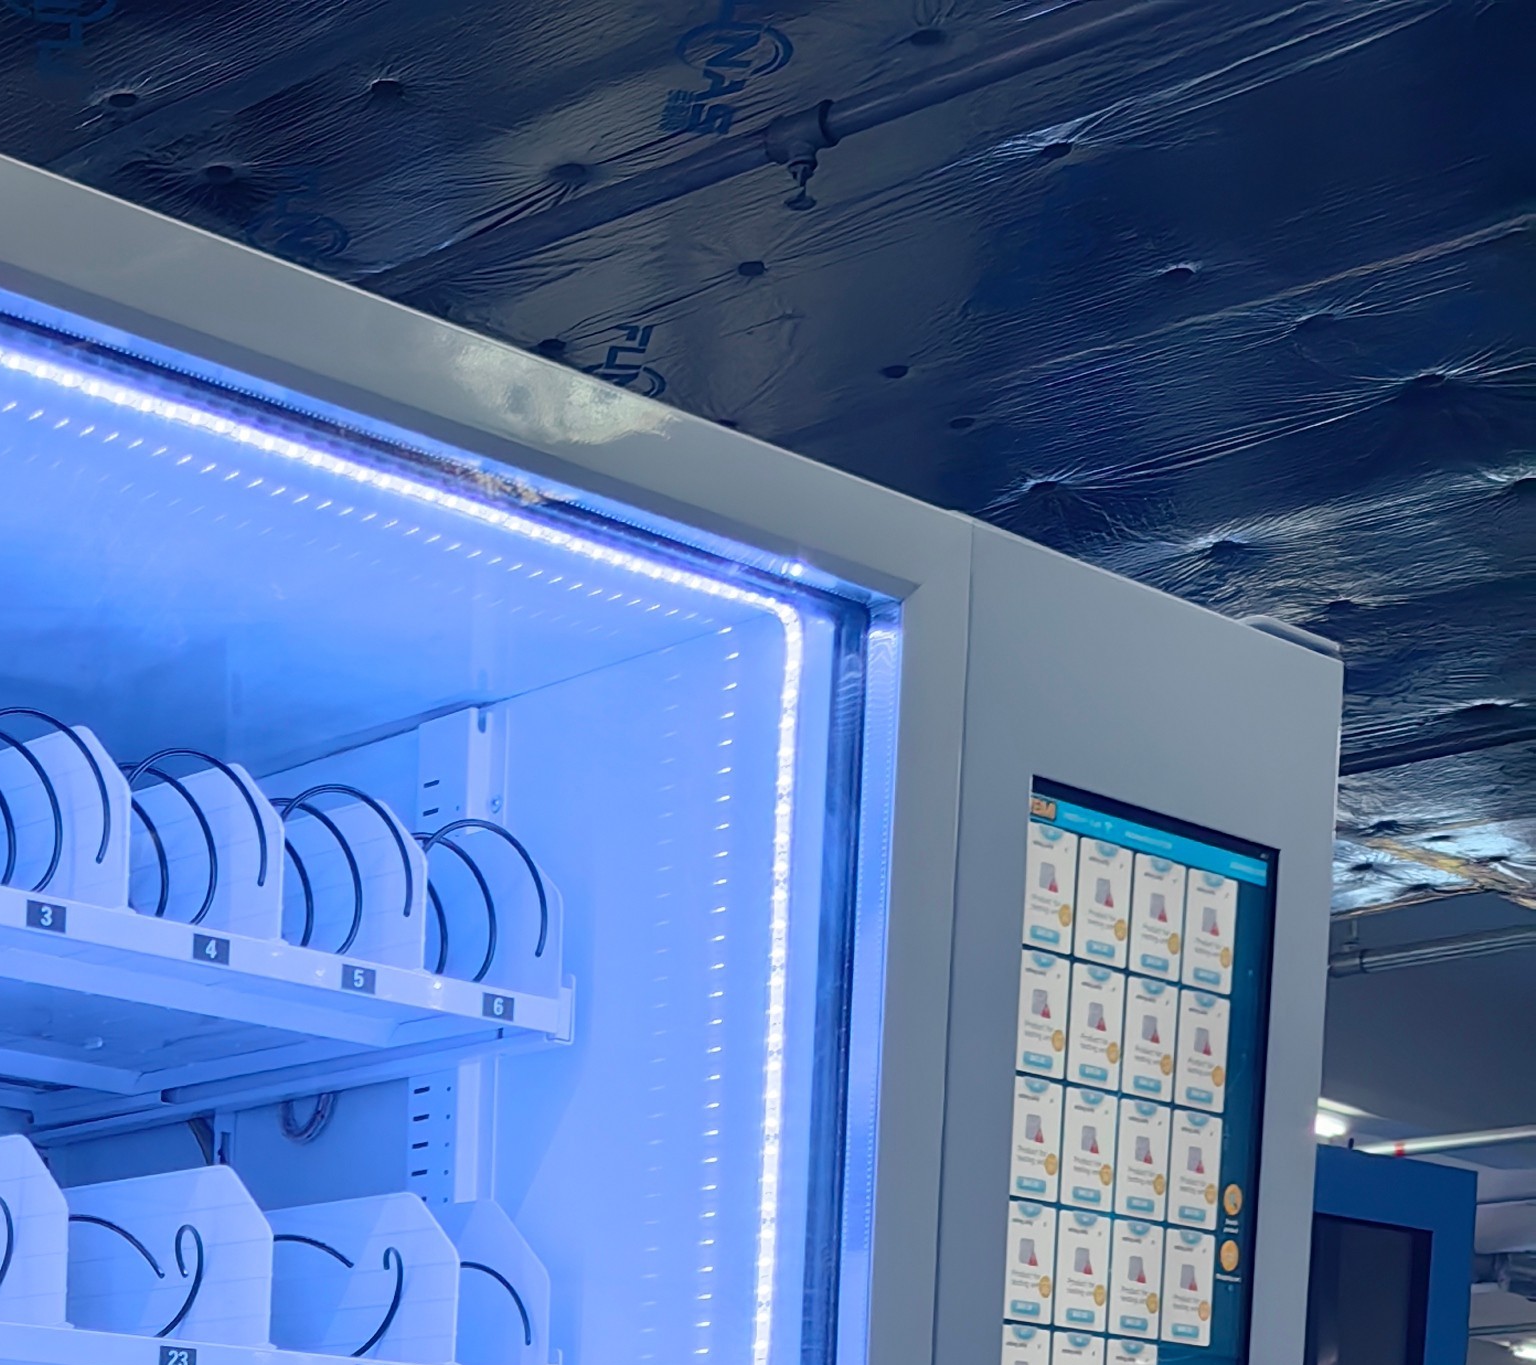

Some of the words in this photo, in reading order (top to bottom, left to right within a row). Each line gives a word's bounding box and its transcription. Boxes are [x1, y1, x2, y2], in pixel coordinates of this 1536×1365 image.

[40, 905, 53, 927] 3
[205, 939, 218, 959] 4
[353, 968, 365, 988] 5
[493, 997, 504, 1016] 6
